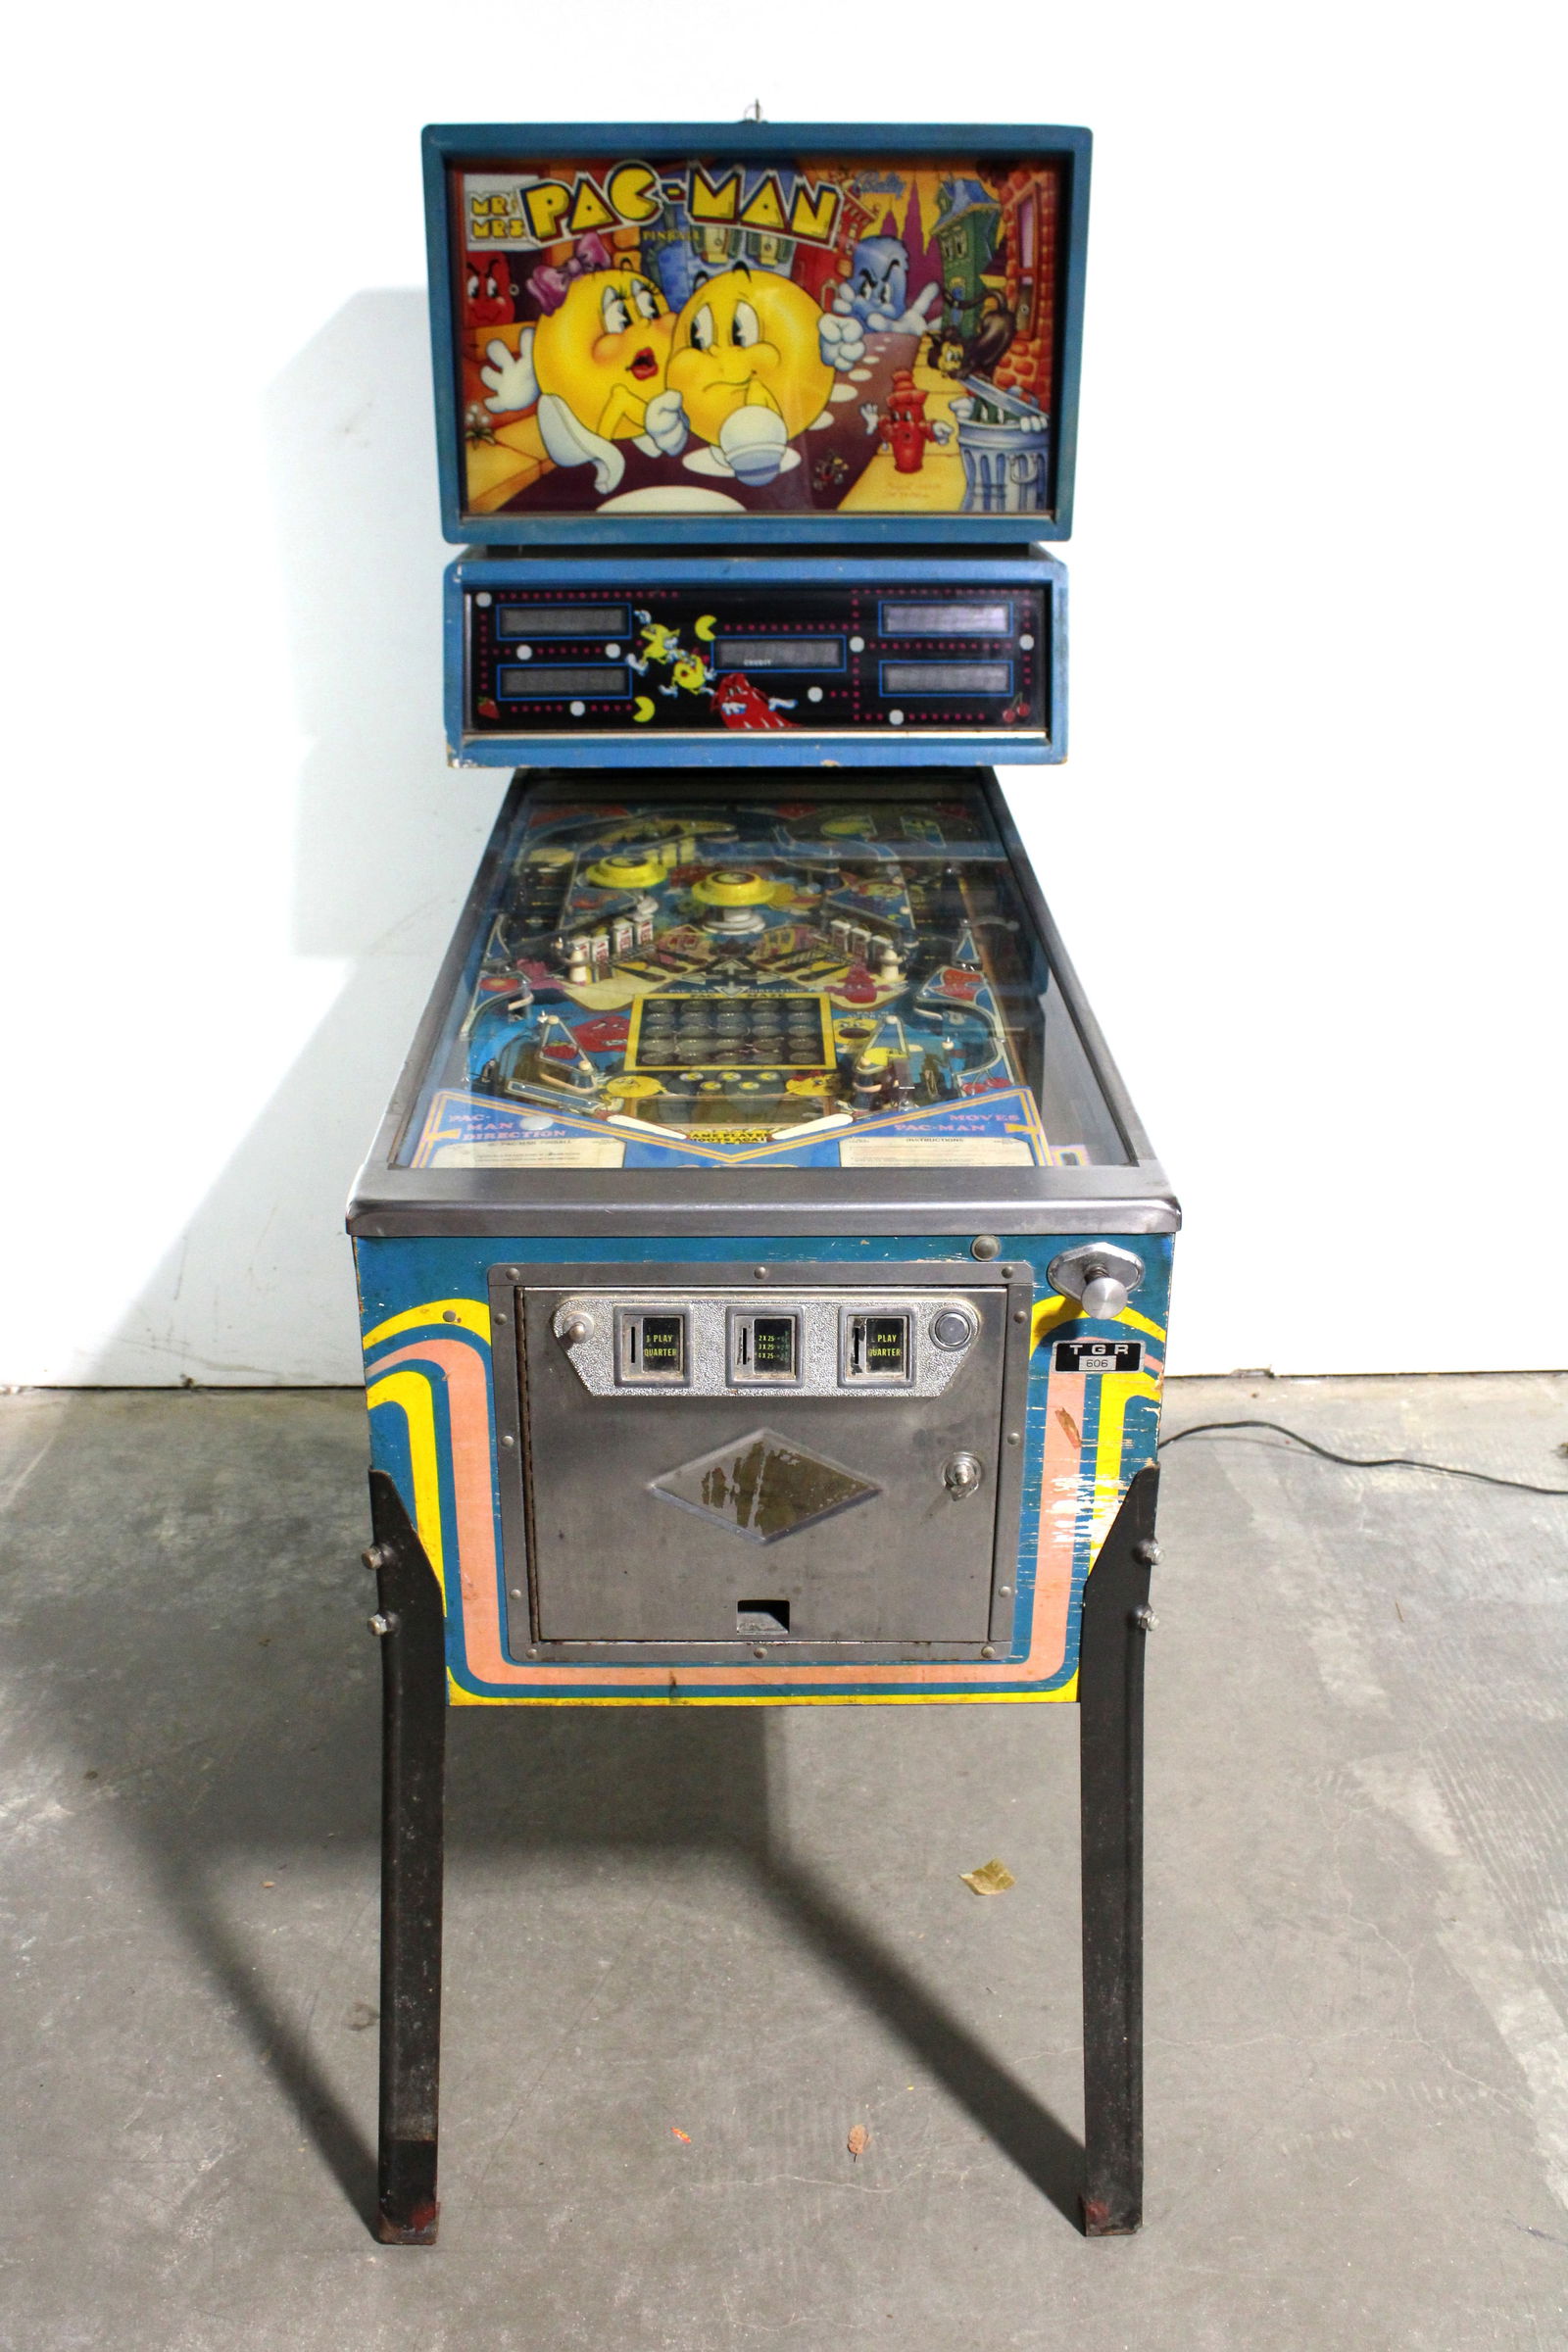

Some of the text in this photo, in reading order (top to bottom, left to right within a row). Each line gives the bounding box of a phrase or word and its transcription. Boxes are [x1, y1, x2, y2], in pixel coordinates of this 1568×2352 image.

[520, 163, 841, 246] PAC-MAN
[949, 1113, 1021, 1122] MOVES
[462, 1130, 566, 1140] DIRECTION
[653, 1334, 673, 1343] PLAY
[877, 1334, 898, 1343] PLAY
[644, 1348, 678, 1357] QUARTER
[868, 1348, 901, 1357] QUARTER
[1086, 1358, 1108, 1368] 606
